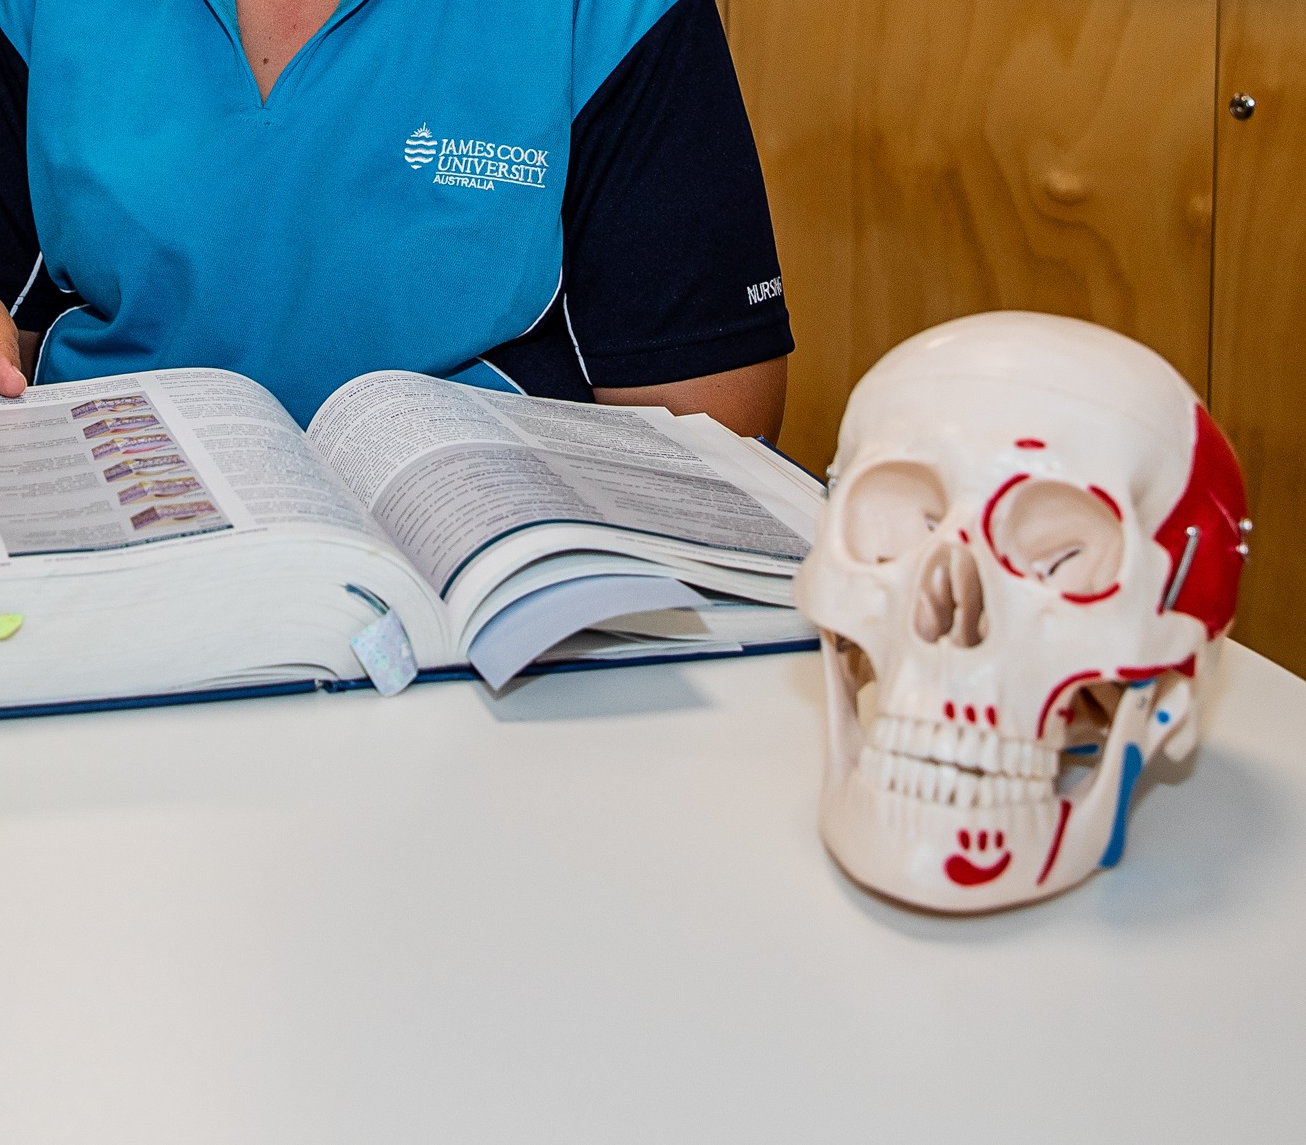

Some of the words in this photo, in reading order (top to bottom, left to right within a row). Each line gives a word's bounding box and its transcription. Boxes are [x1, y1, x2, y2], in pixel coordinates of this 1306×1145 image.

[439, 138, 496, 158] JAMES
[497, 144, 550, 167] COOK
[433, 174, 495, 191] AUSTRALIA
[437, 156, 547, 184] UNIVERSITY
